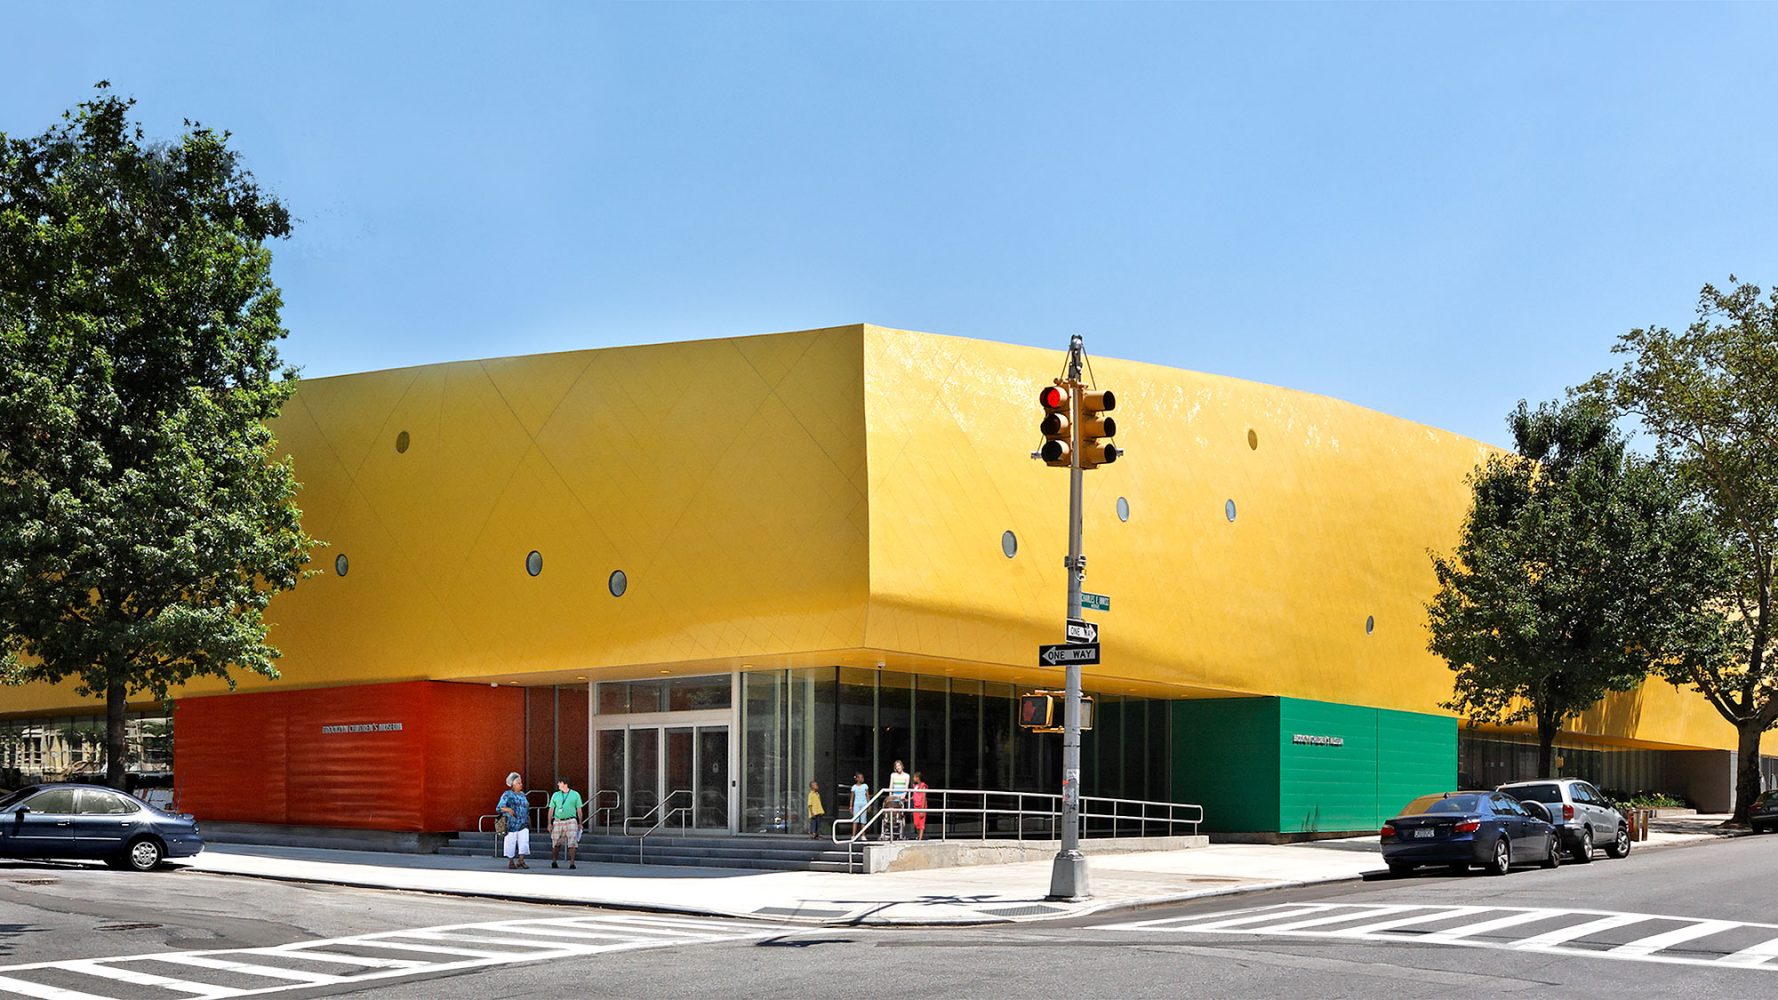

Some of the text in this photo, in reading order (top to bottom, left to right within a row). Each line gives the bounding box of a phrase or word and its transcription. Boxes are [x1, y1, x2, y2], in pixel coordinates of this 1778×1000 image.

[1070, 626, 1094, 638] ONE WAY
[1048, 649, 1092, 660] ONE WAY
